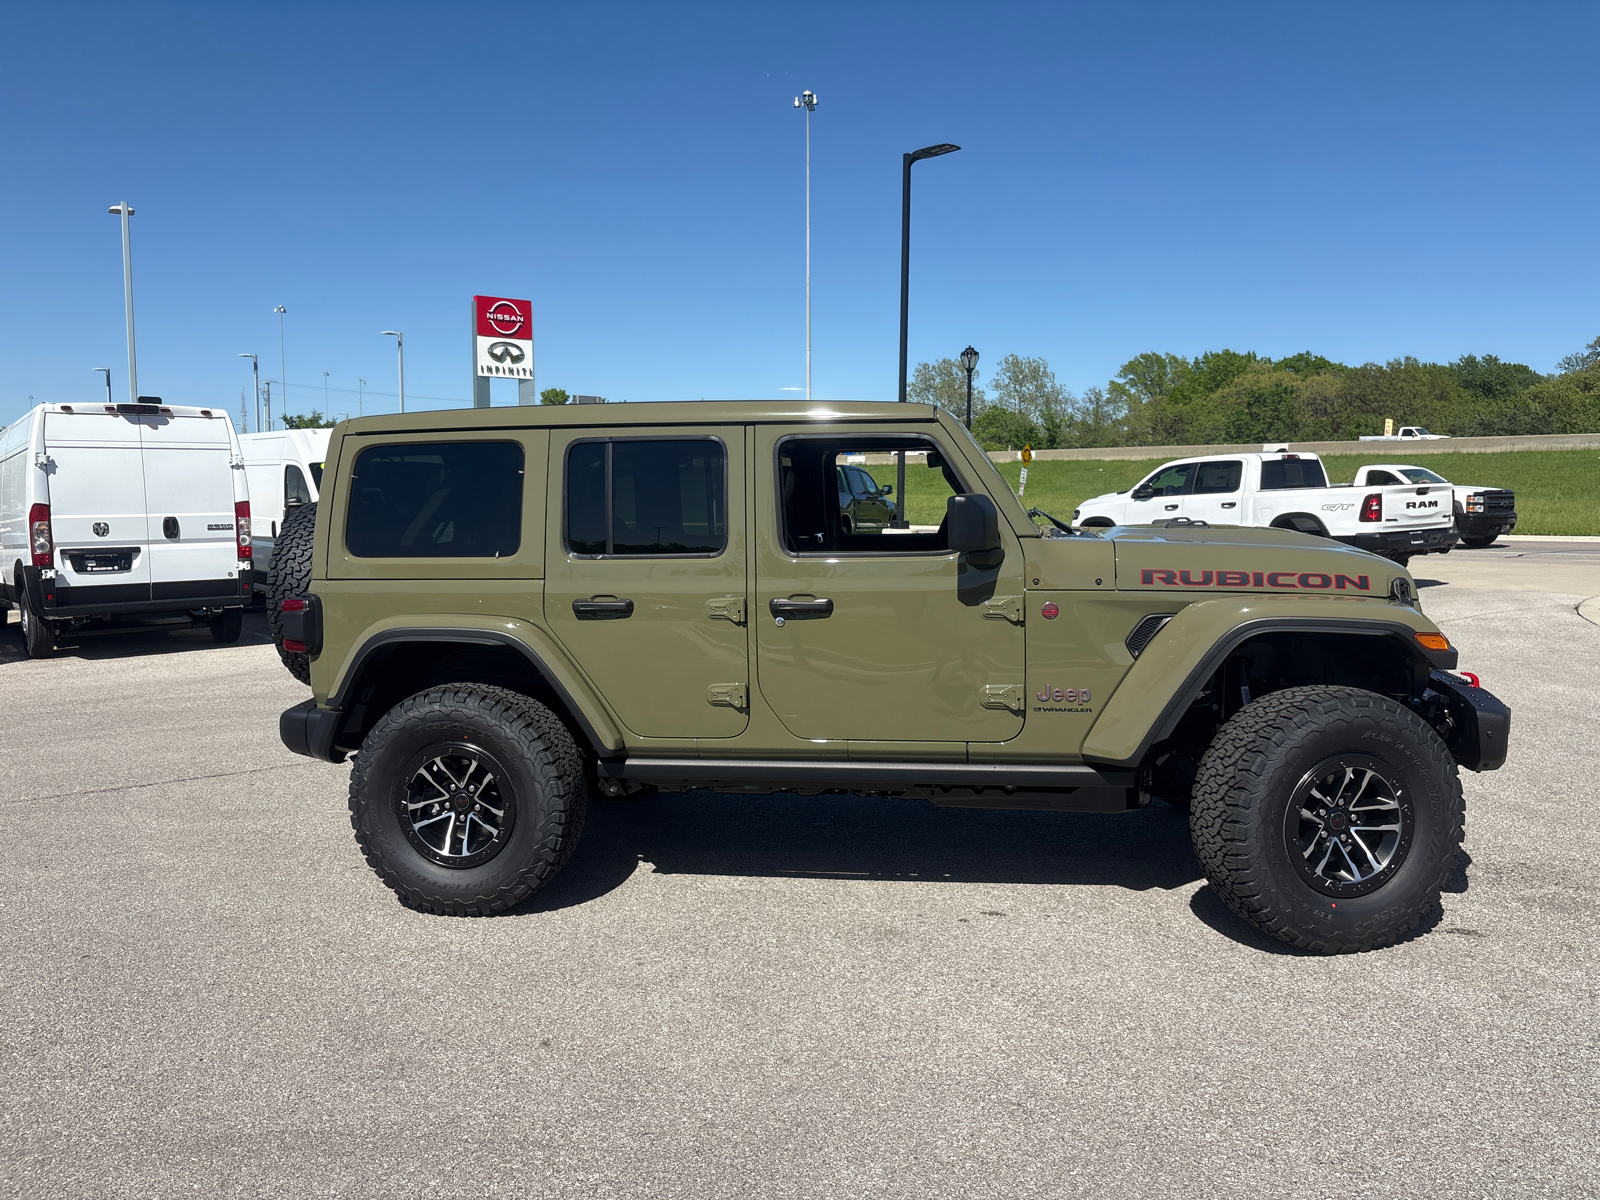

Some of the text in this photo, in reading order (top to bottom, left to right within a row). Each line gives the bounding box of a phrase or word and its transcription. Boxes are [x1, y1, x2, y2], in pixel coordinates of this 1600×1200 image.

[486, 313, 524, 322] NISSAN
[481, 365, 533, 377] INFINITI
[1405, 500, 1438, 509] RAM
[1141, 569, 1371, 591] RUBICON
[1036, 683, 1092, 706] Jeep
